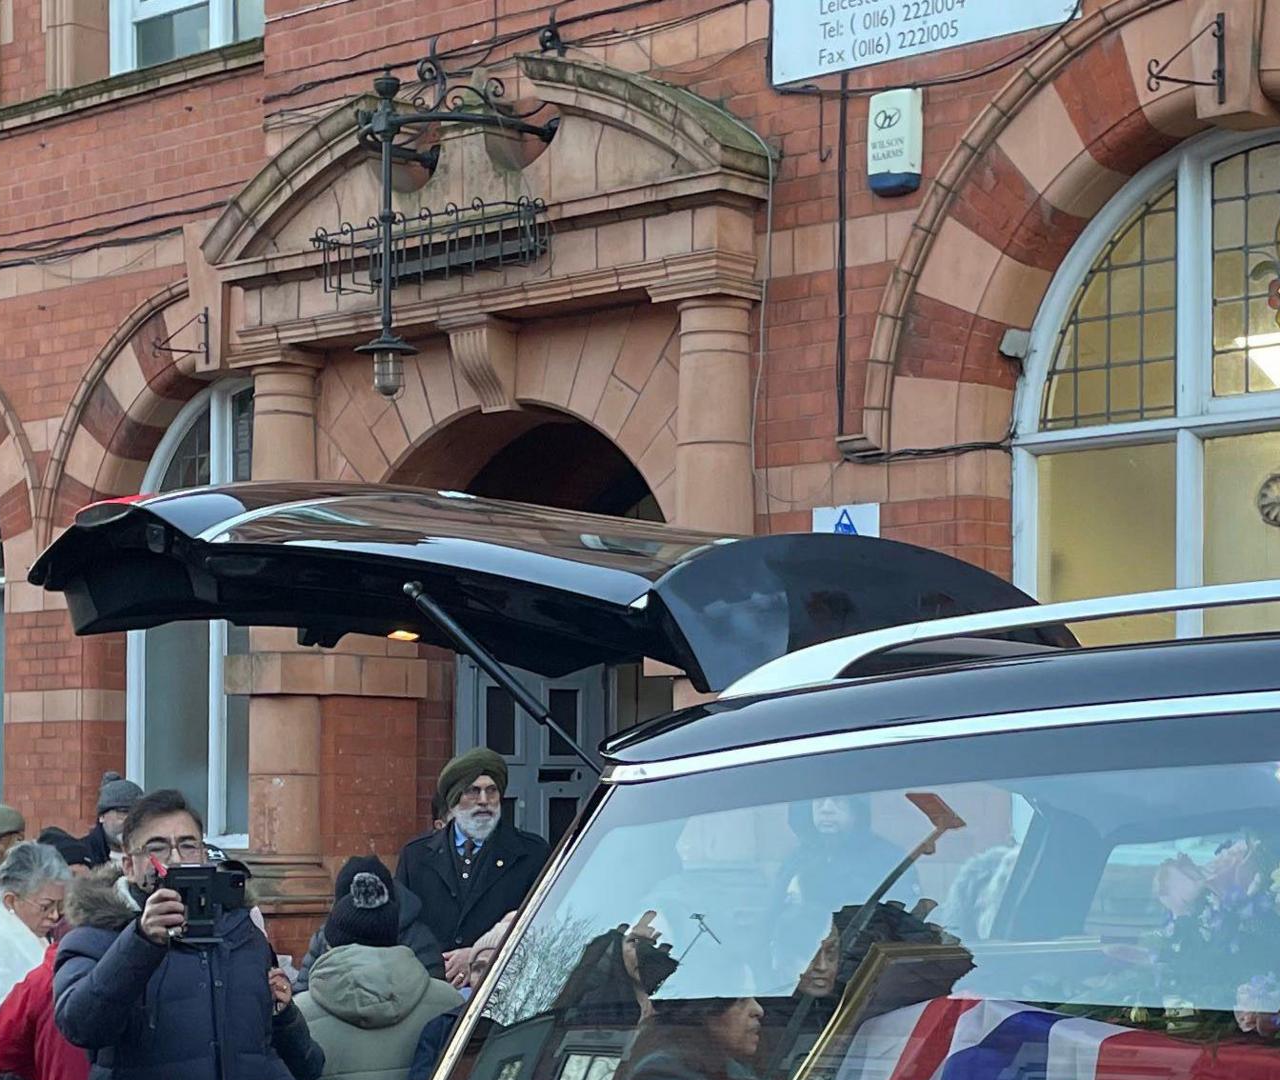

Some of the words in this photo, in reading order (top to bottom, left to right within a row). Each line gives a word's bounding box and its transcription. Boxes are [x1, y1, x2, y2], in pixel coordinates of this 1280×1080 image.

[821, 22, 843, 39] Tel:
[819, 47, 844, 66] Fax
[852, 32, 890, 61] (0116)
[898, 20, 958, 49] 2221005
[871, 137, 904, 149] WILSON
